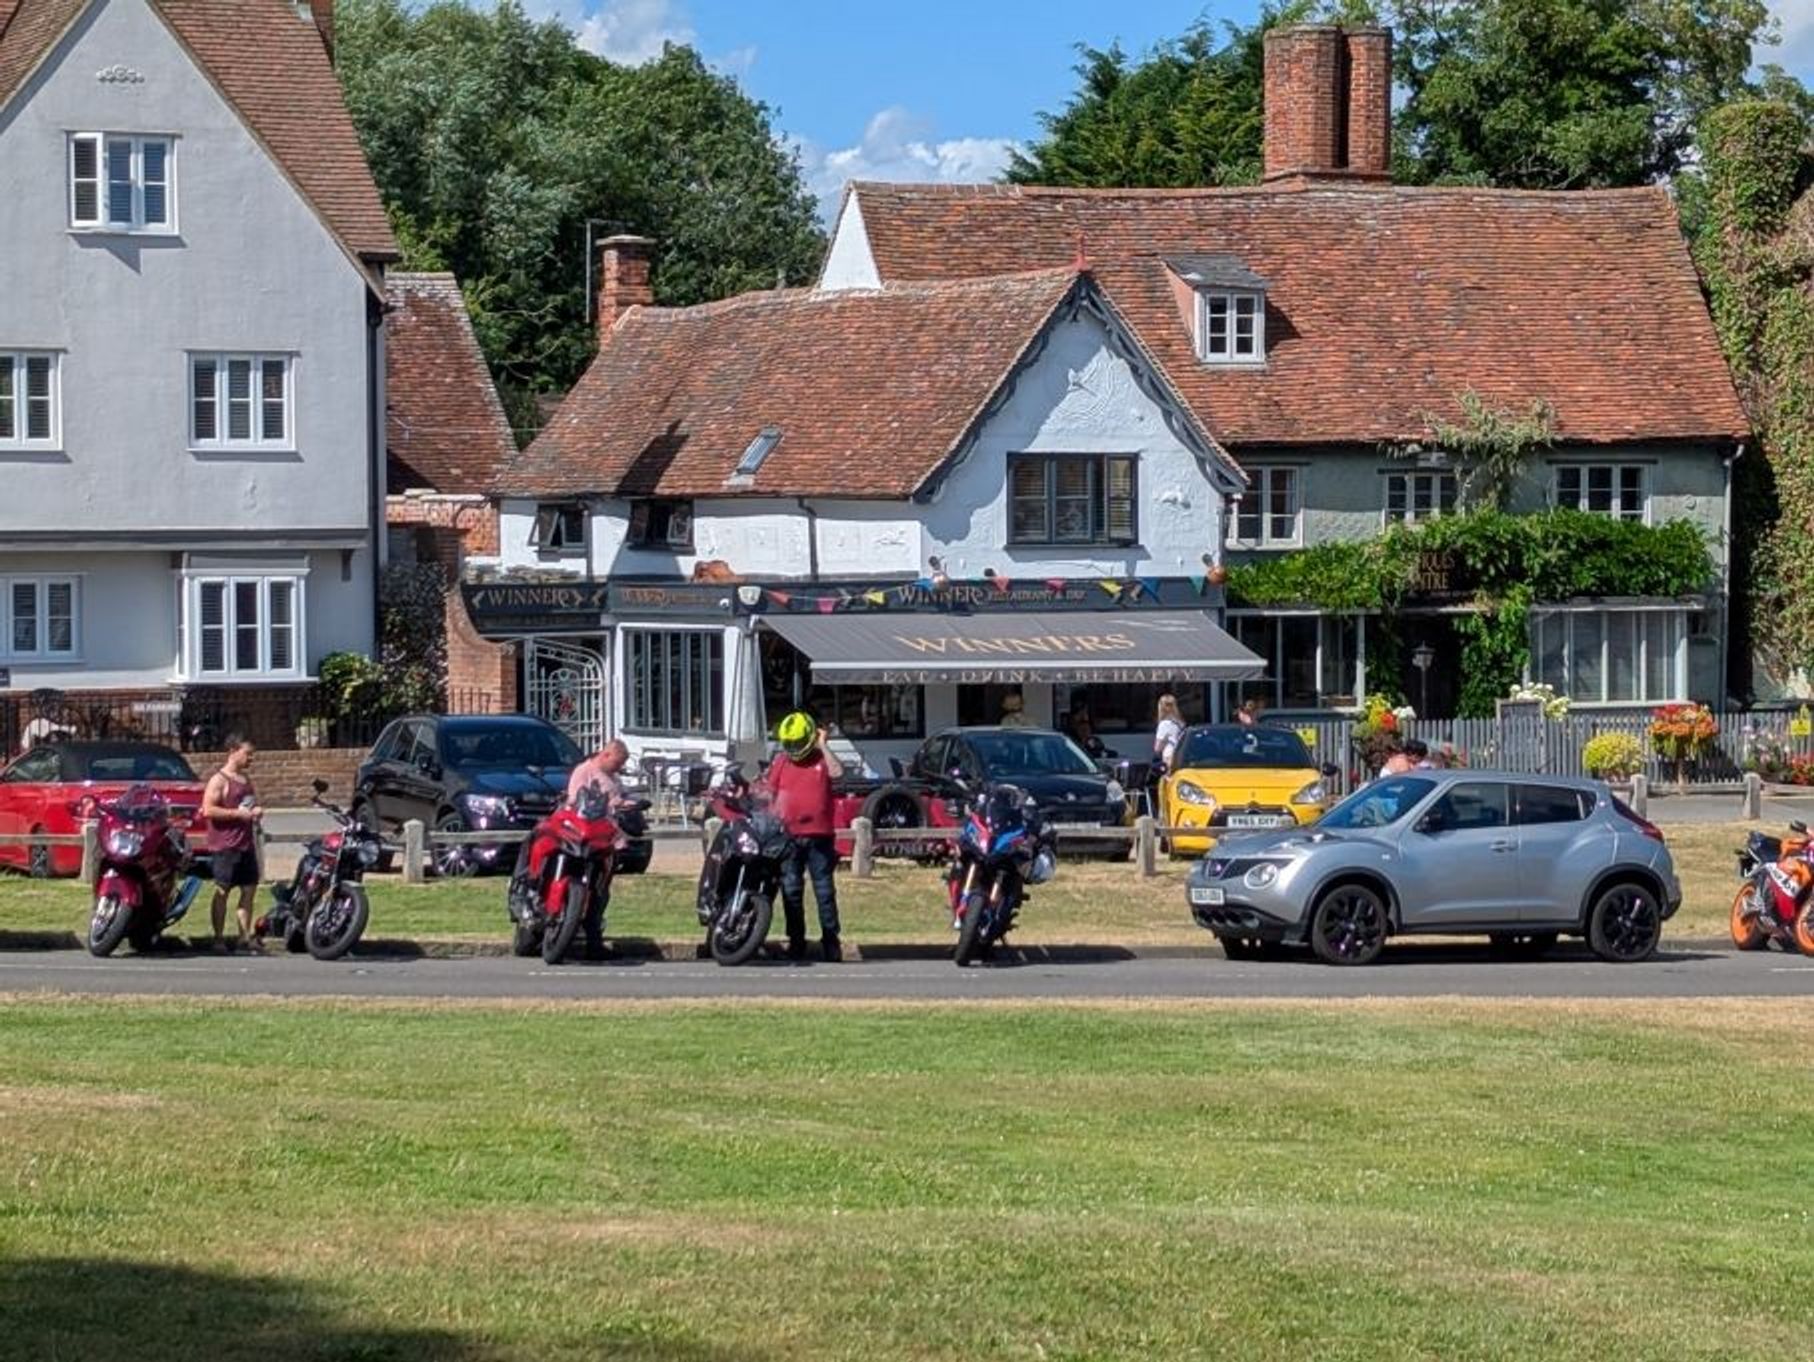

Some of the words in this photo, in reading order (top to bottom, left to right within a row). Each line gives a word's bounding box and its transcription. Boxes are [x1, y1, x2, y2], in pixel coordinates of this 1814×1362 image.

[894, 633, 1136, 654] WINNERS
[882, 670, 929, 683] EAT
[961, 670, 1043, 683] DRINK
[1075, 669, 1100, 682] BE
[1112, 669, 1195, 682] HAPPY
